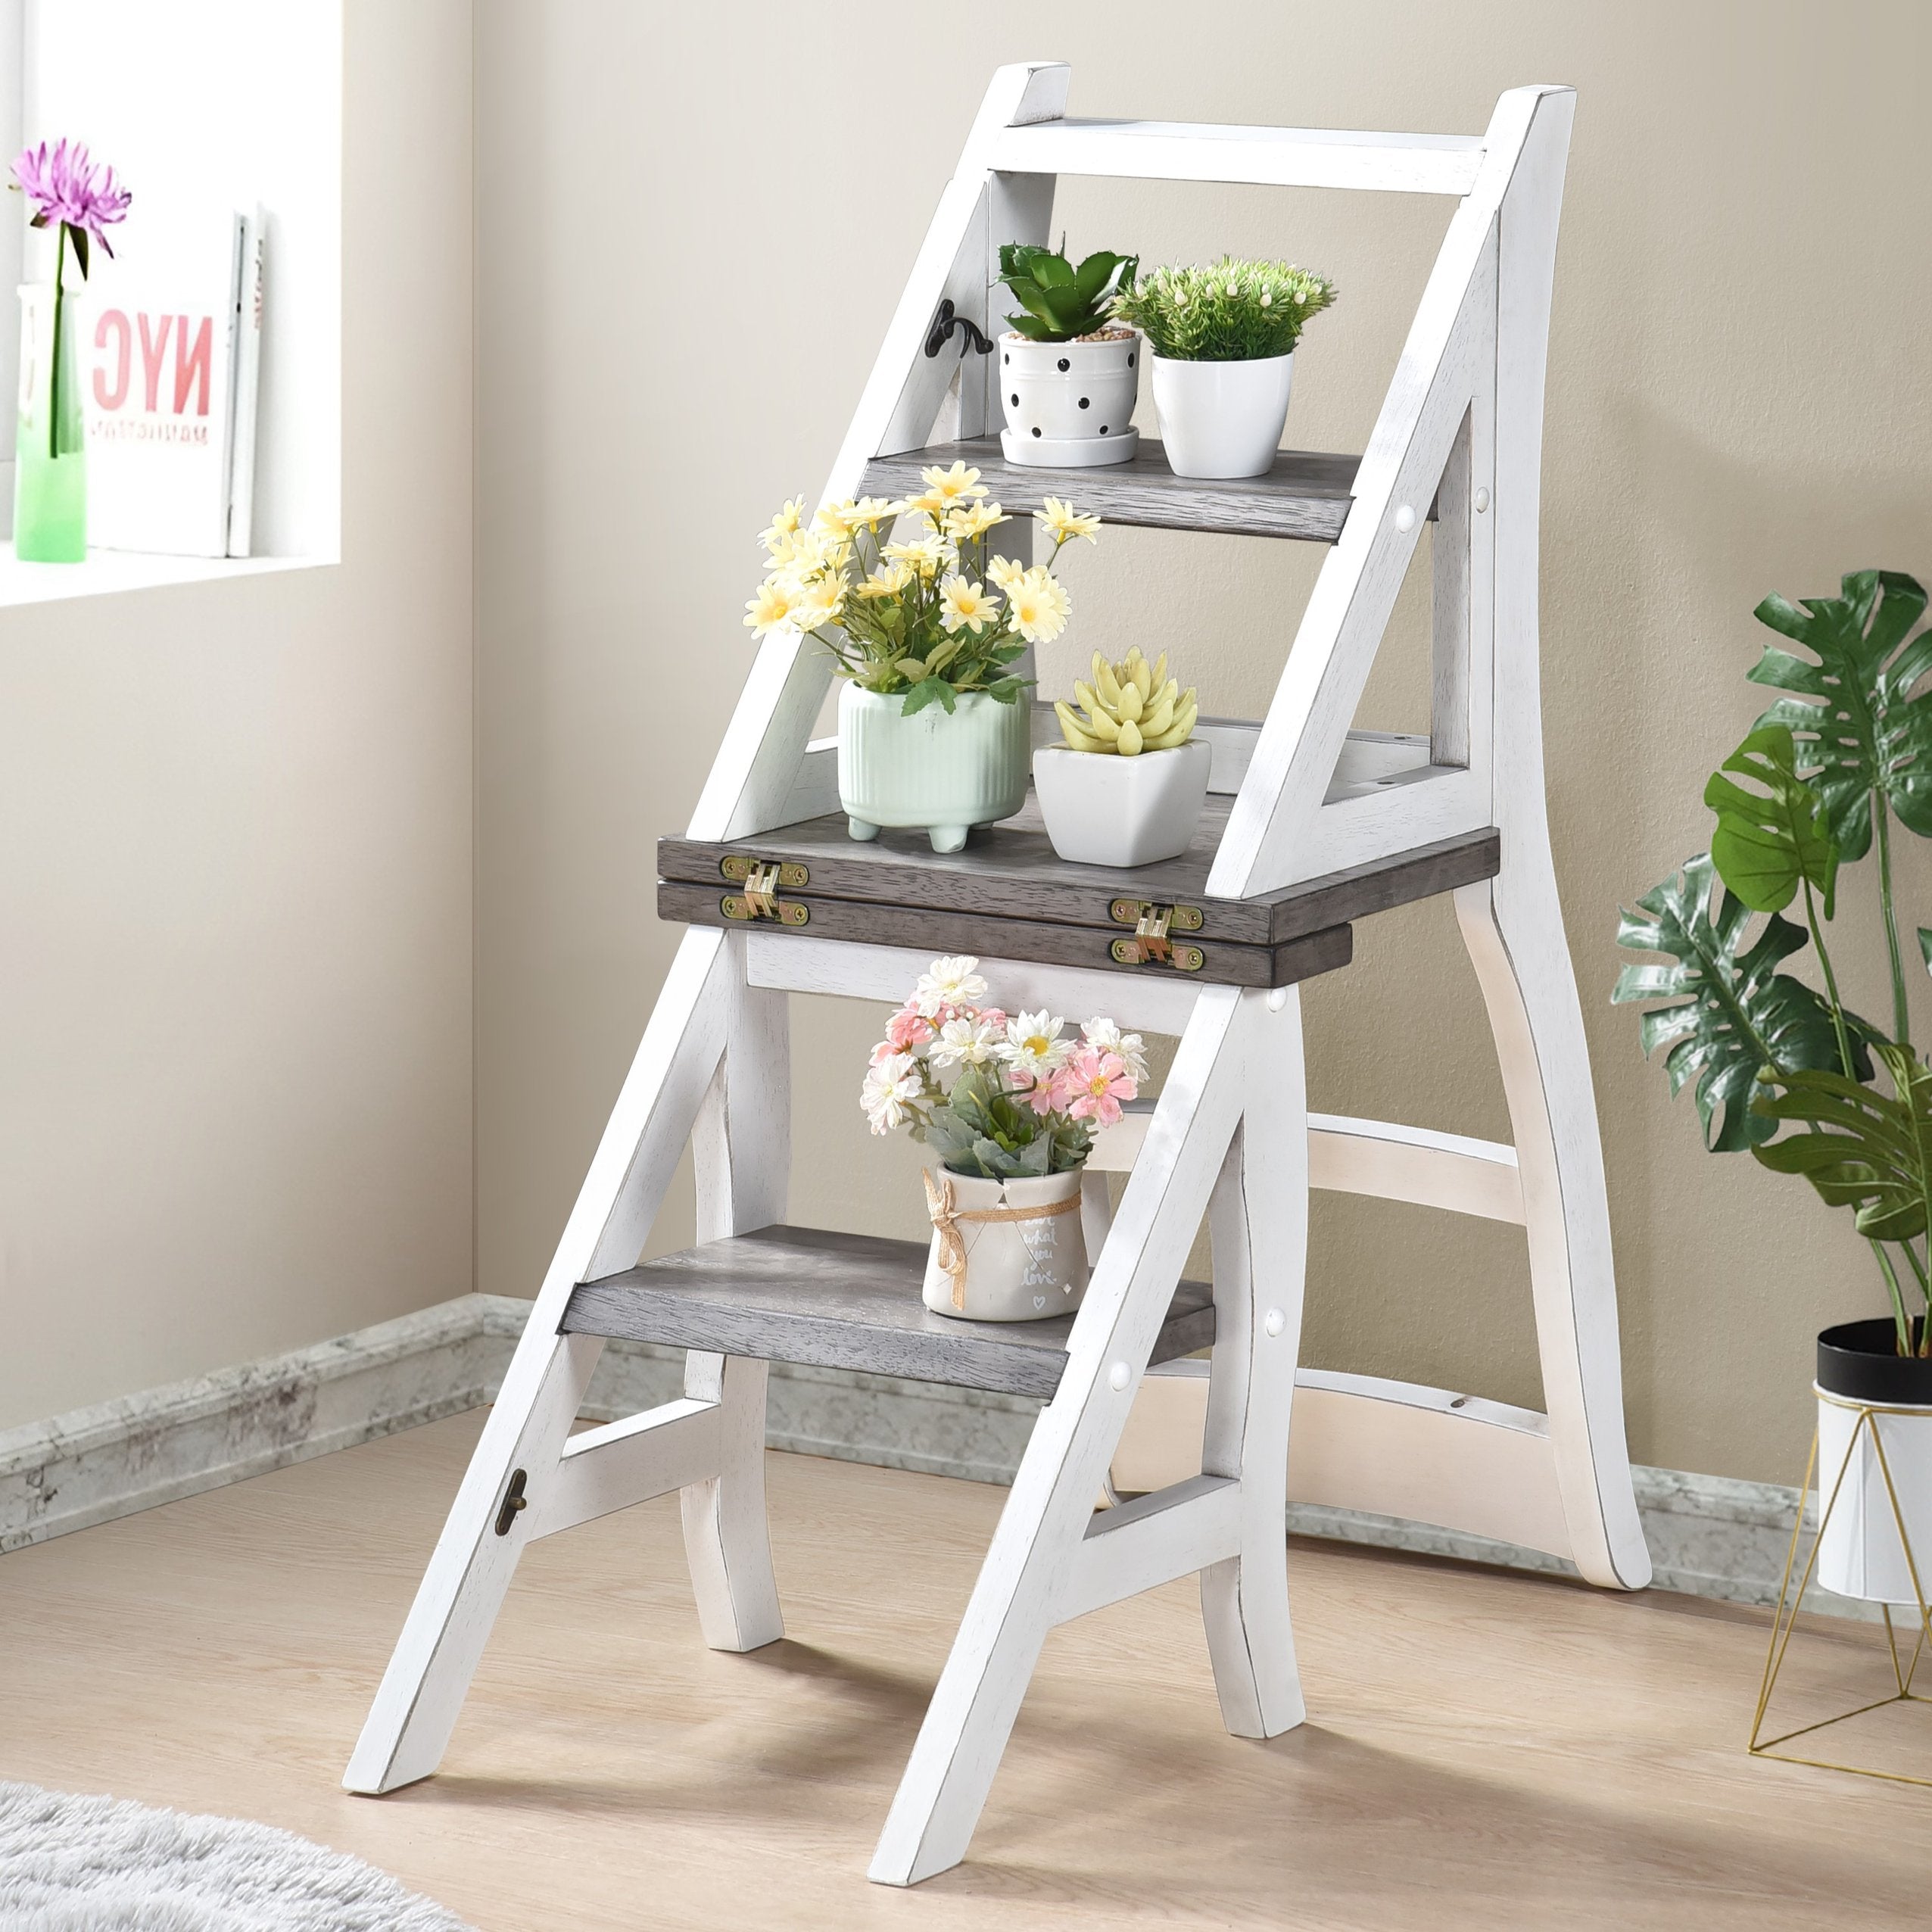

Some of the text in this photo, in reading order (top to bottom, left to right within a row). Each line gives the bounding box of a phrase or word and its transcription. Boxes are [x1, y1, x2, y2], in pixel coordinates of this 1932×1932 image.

[1023, 1227, 1058, 1245] what
[1030, 1249, 1053, 1270] you
[1021, 1267, 1057, 1285] love
